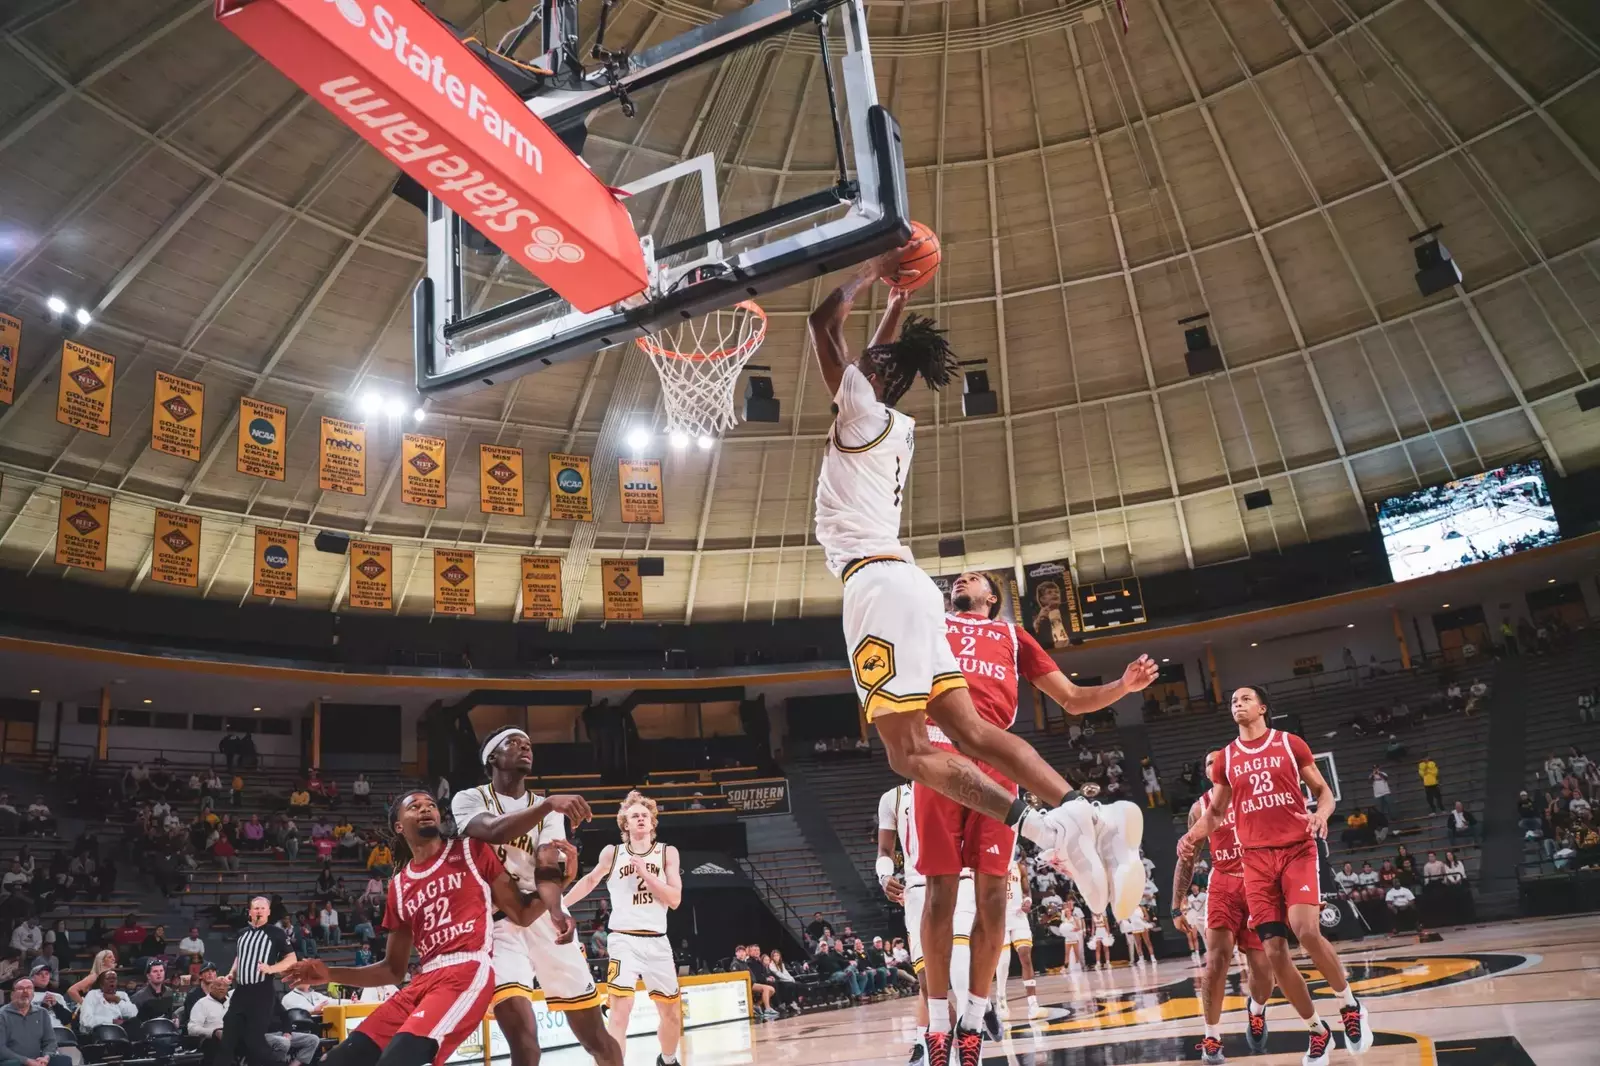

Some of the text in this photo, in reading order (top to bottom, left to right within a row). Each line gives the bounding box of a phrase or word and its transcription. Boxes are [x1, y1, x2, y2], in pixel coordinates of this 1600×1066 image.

[66, 343, 113, 364] SOUTHERN
[78, 355, 100, 367] MISS
[158, 374, 202, 392] SOUTHERN
[170, 385, 191, 395] MISS
[66, 391, 104, 407] GOLDEN
[67, 397, 103, 412] EAGLES
[171, 404, 187, 413] NIT
[243, 400, 285, 415] SOUTHERN
[60, 407, 108, 425] TOURNAMENT
[254, 410, 273, 419] MISS
[68, 417, 98, 430] 17-12
[160, 420, 195, 433] GOLDEN
[323, 419, 364, 431] SOUTHERN
[160, 426, 194, 437] EAGLES
[252, 429, 275, 441] NCAA
[154, 435, 199, 450] TOURNAMENT
[405, 435, 444, 447] SOUTHERN
[162, 444, 190, 456] 23-11
[244, 443, 279, 455] GOLDEN
[245, 449, 278, 460] EAGLES
[482, 446, 521, 455] SOUTHERN
[327, 453, 359, 463] GOLDEN
[328, 458, 358, 467] EAGLES
[240, 458, 283, 472] TOURNAMENT
[246, 466, 275, 476] 20-12
[408, 476, 440, 484] GOLDEN
[64, 490, 108, 505] SOUTHERN
[412, 497, 437, 505] 17-13
[75, 500, 96, 509] MISS
[158, 511, 199, 524] SOUTHERN
[168, 520, 188, 528] MISS
[64, 534, 100, 545] GOLDEN
[257, 529, 297, 539] SOUTHERN
[65, 540, 99, 550] EAGLES
[352, 543, 390, 551] SOUTHERN
[67, 557, 95, 567] 23-11
[159, 553, 192, 562] GOLDEN
[160, 558, 191, 566] EAGLES
[266, 556, 288, 564] NCAA
[261, 568, 292, 576] GOLDEN
[261, 573, 291, 581] EAGLES
[948, 624, 1006, 641] AGIN'
[959, 636, 976, 656] 2
[1233, 756, 1284, 777] RAGIN'
[1249, 771, 1274, 795] 23
[727, 787, 784, 802] SOUTHERN
[743, 800, 767, 810] MISS
[1241, 792, 1295, 814] CAJUNS
[619, 862, 660, 880] SOUERN
[636, 875, 647, 891] 2
[405, 872, 467, 917] RAGIN'
[633, 893, 653, 905] MISS
[423, 897, 452, 931] 52
